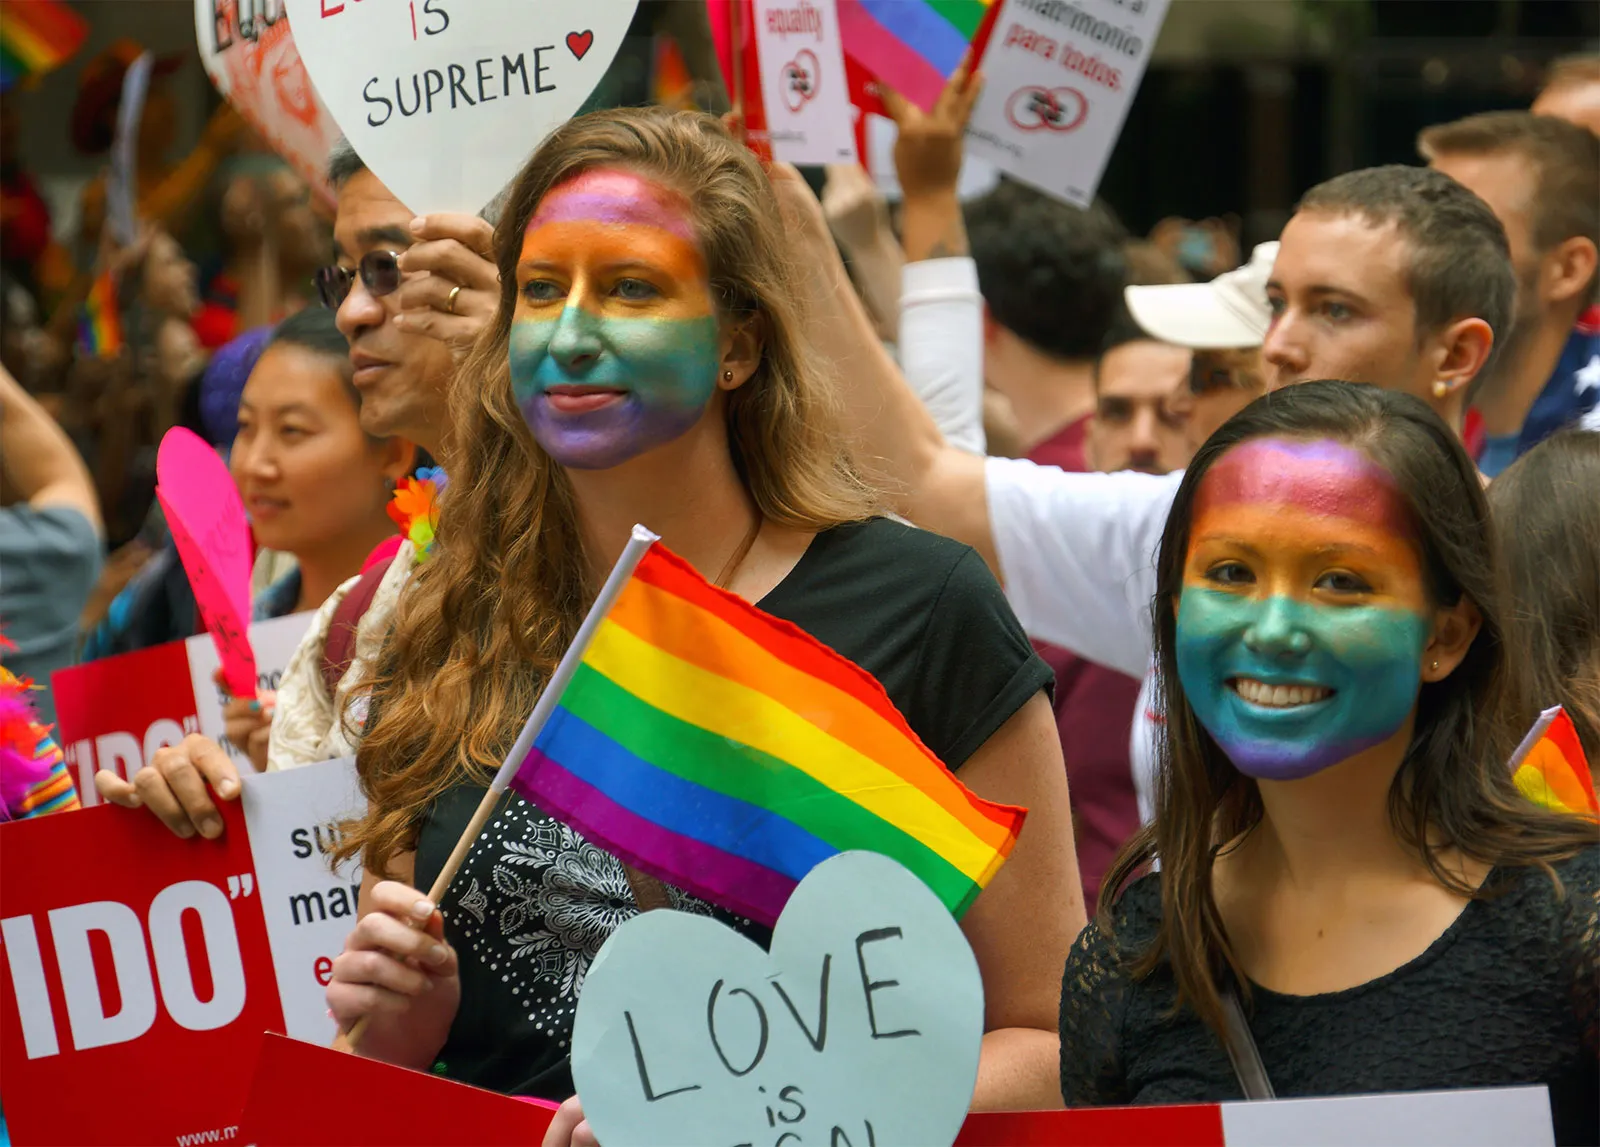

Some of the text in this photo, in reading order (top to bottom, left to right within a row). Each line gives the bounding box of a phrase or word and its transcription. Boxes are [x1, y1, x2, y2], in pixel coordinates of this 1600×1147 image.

[409, 0, 450, 41] IS
[1004, 23, 1058, 60] para
[362, 45, 556, 127] SUPREME
[624, 926, 922, 1101] LOVE
[758, 1085, 806, 1128] is
